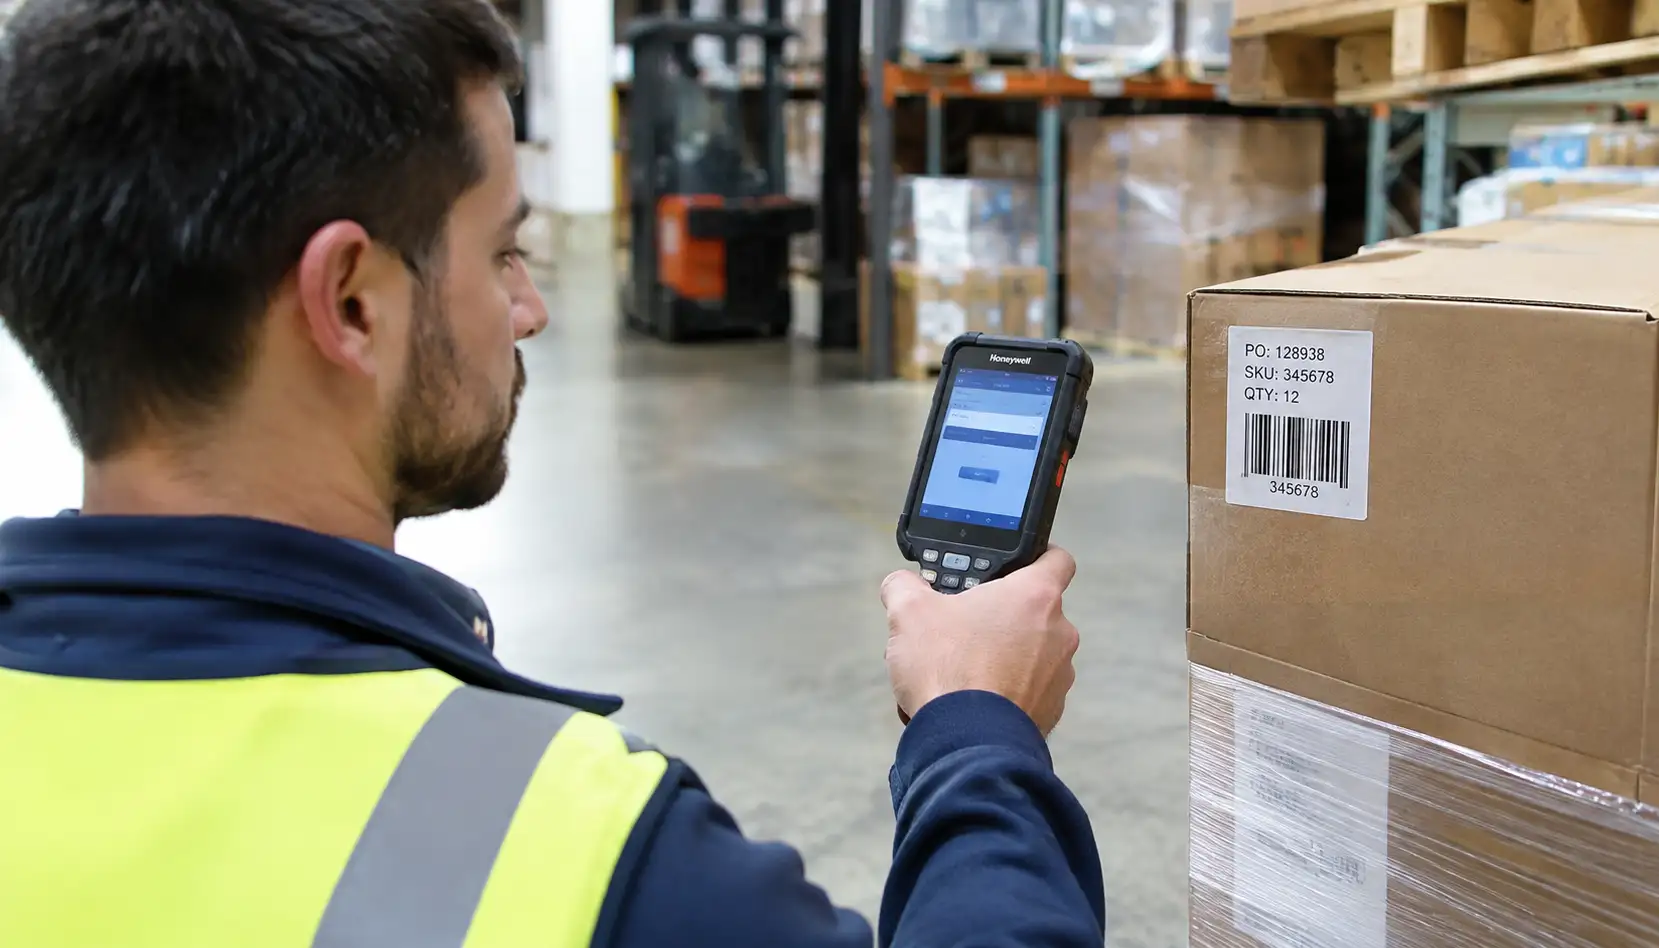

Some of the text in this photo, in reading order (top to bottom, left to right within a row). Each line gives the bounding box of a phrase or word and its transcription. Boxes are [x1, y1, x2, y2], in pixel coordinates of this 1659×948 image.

[989, 353, 1032, 365] Honeywell
[1245, 343, 1325, 361] PO: 128938
[1244, 365, 1335, 384] SKU: 345678
[1244, 386, 1300, 404] QTY: 12
[1269, 480, 1319, 499] 345678
